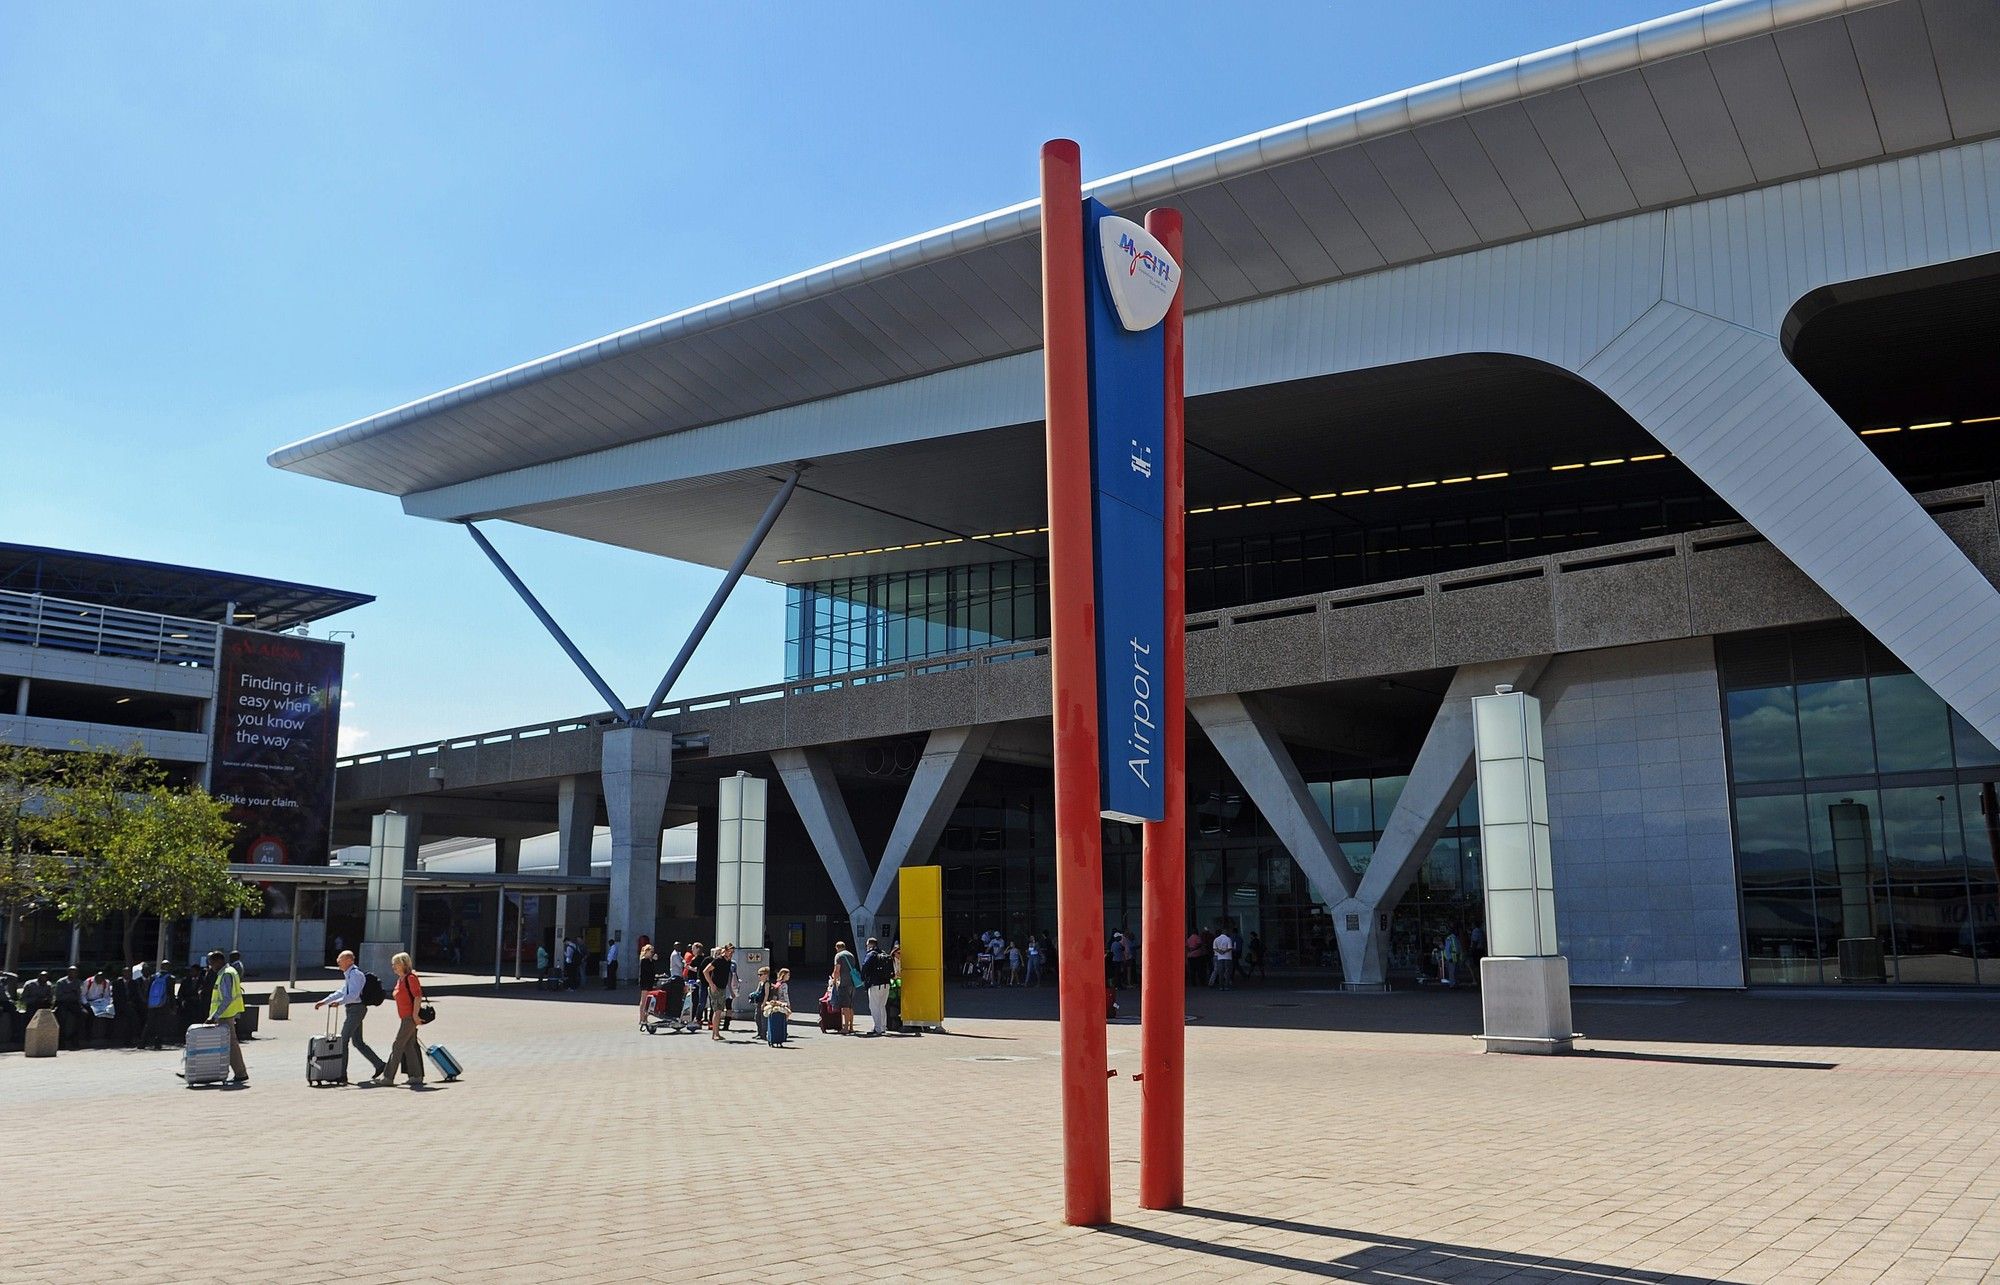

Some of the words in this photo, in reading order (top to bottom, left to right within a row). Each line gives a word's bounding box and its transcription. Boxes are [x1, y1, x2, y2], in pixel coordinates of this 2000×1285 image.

[241, 674, 291, 695] Finding
[294, 681, 304, 694] it
[307, 682, 318, 696] is
[238, 695, 270, 711] easy
[273, 697, 311, 712] when
[1128, 637, 1155, 788] Airport
[237, 713, 263, 727] you
[267, 714, 305, 730] know
[236, 729, 259, 745] the
[262, 735, 290, 750] way
[219, 793, 246, 805] Stake
[247, 797, 270, 807] your
[271, 797, 299, 808] claim.
[260, 855, 274, 863] Au
